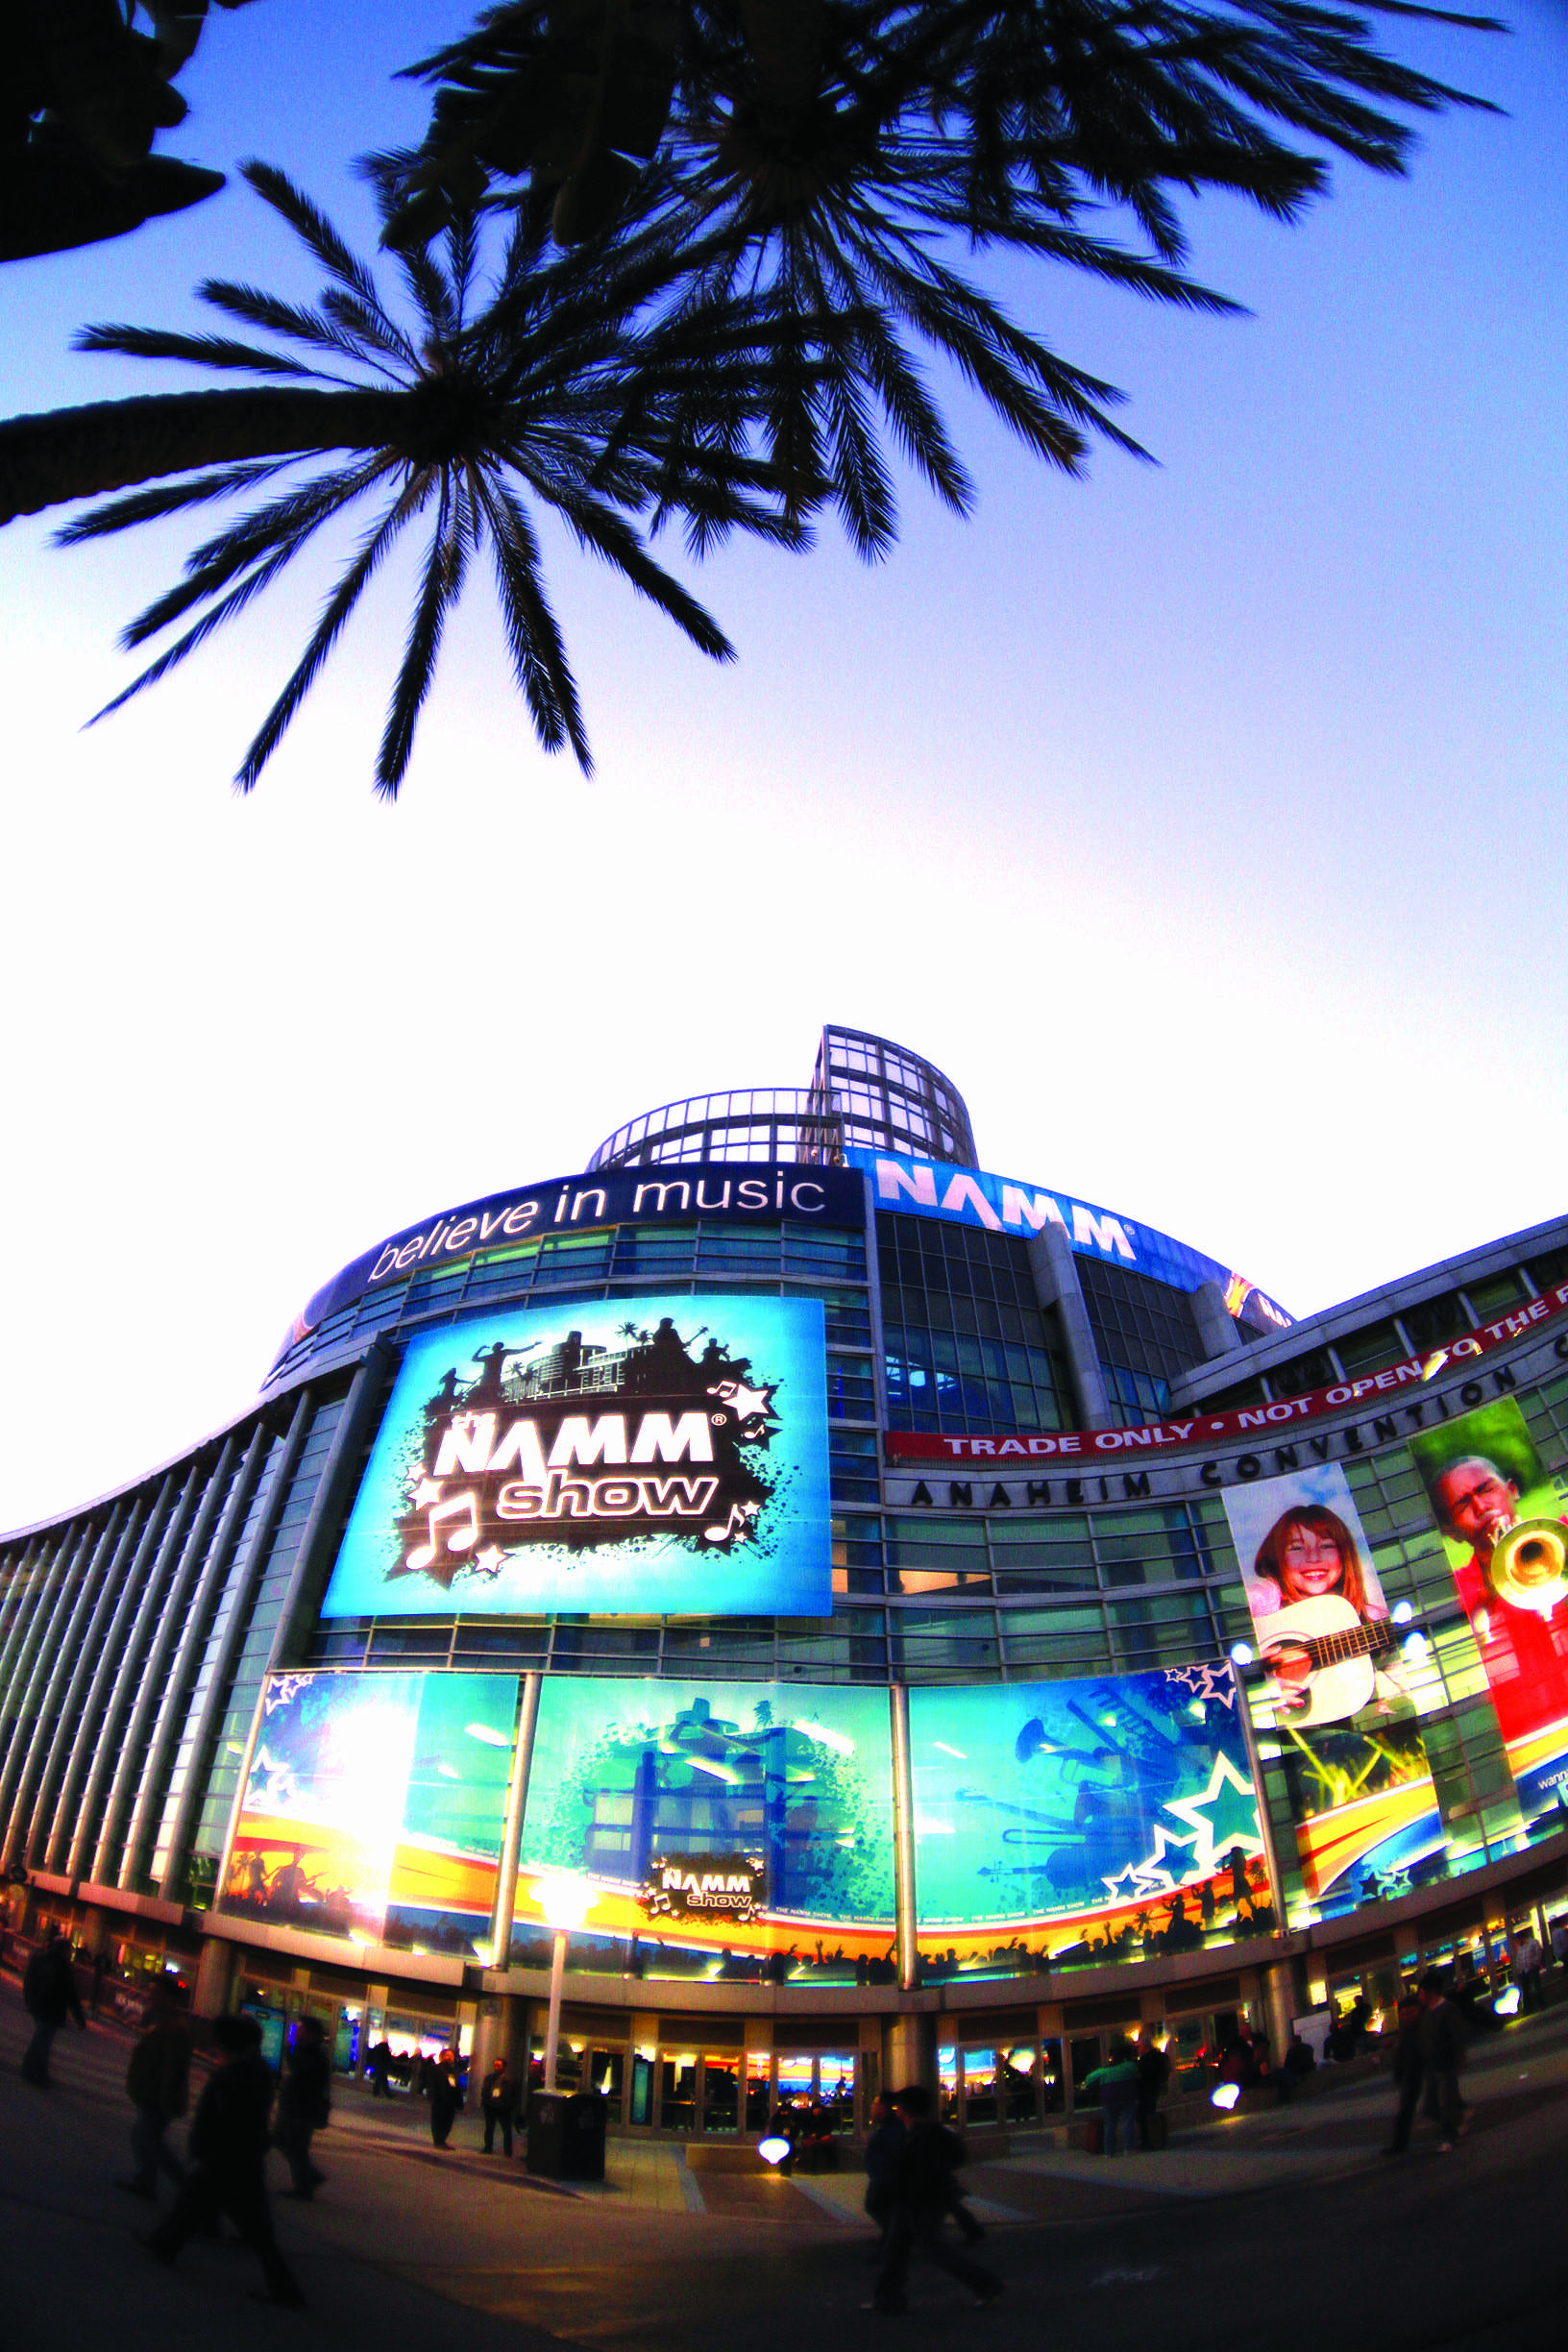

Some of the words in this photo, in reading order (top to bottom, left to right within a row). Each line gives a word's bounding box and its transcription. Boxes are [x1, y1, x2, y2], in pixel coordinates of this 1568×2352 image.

[368, 1200, 539, 1283] believe
[554, 1185, 606, 1222] in
[633, 1171, 825, 1213] music
[876, 1159, 1137, 1261] NAMM
[943, 1437, 1082, 1456] TRADE
[1095, 1422, 1194, 1450] ONLY
[1237, 1397, 1313, 1429] NOT
[1326, 1360, 1423, 1405] OPEN
[1484, 1300, 1550, 1340] THE
[432, 1413, 713, 1481] NAMM
[911, 1472, 1151, 1506] ANAHEIM
[1201, 1366, 1516, 1485] CONVENTION
[496, 1469, 719, 1519] show
[1537, 1770, 1568, 1790] wann
[662, 1872, 749, 1895] NAMM
[687, 1892, 751, 1908] show
